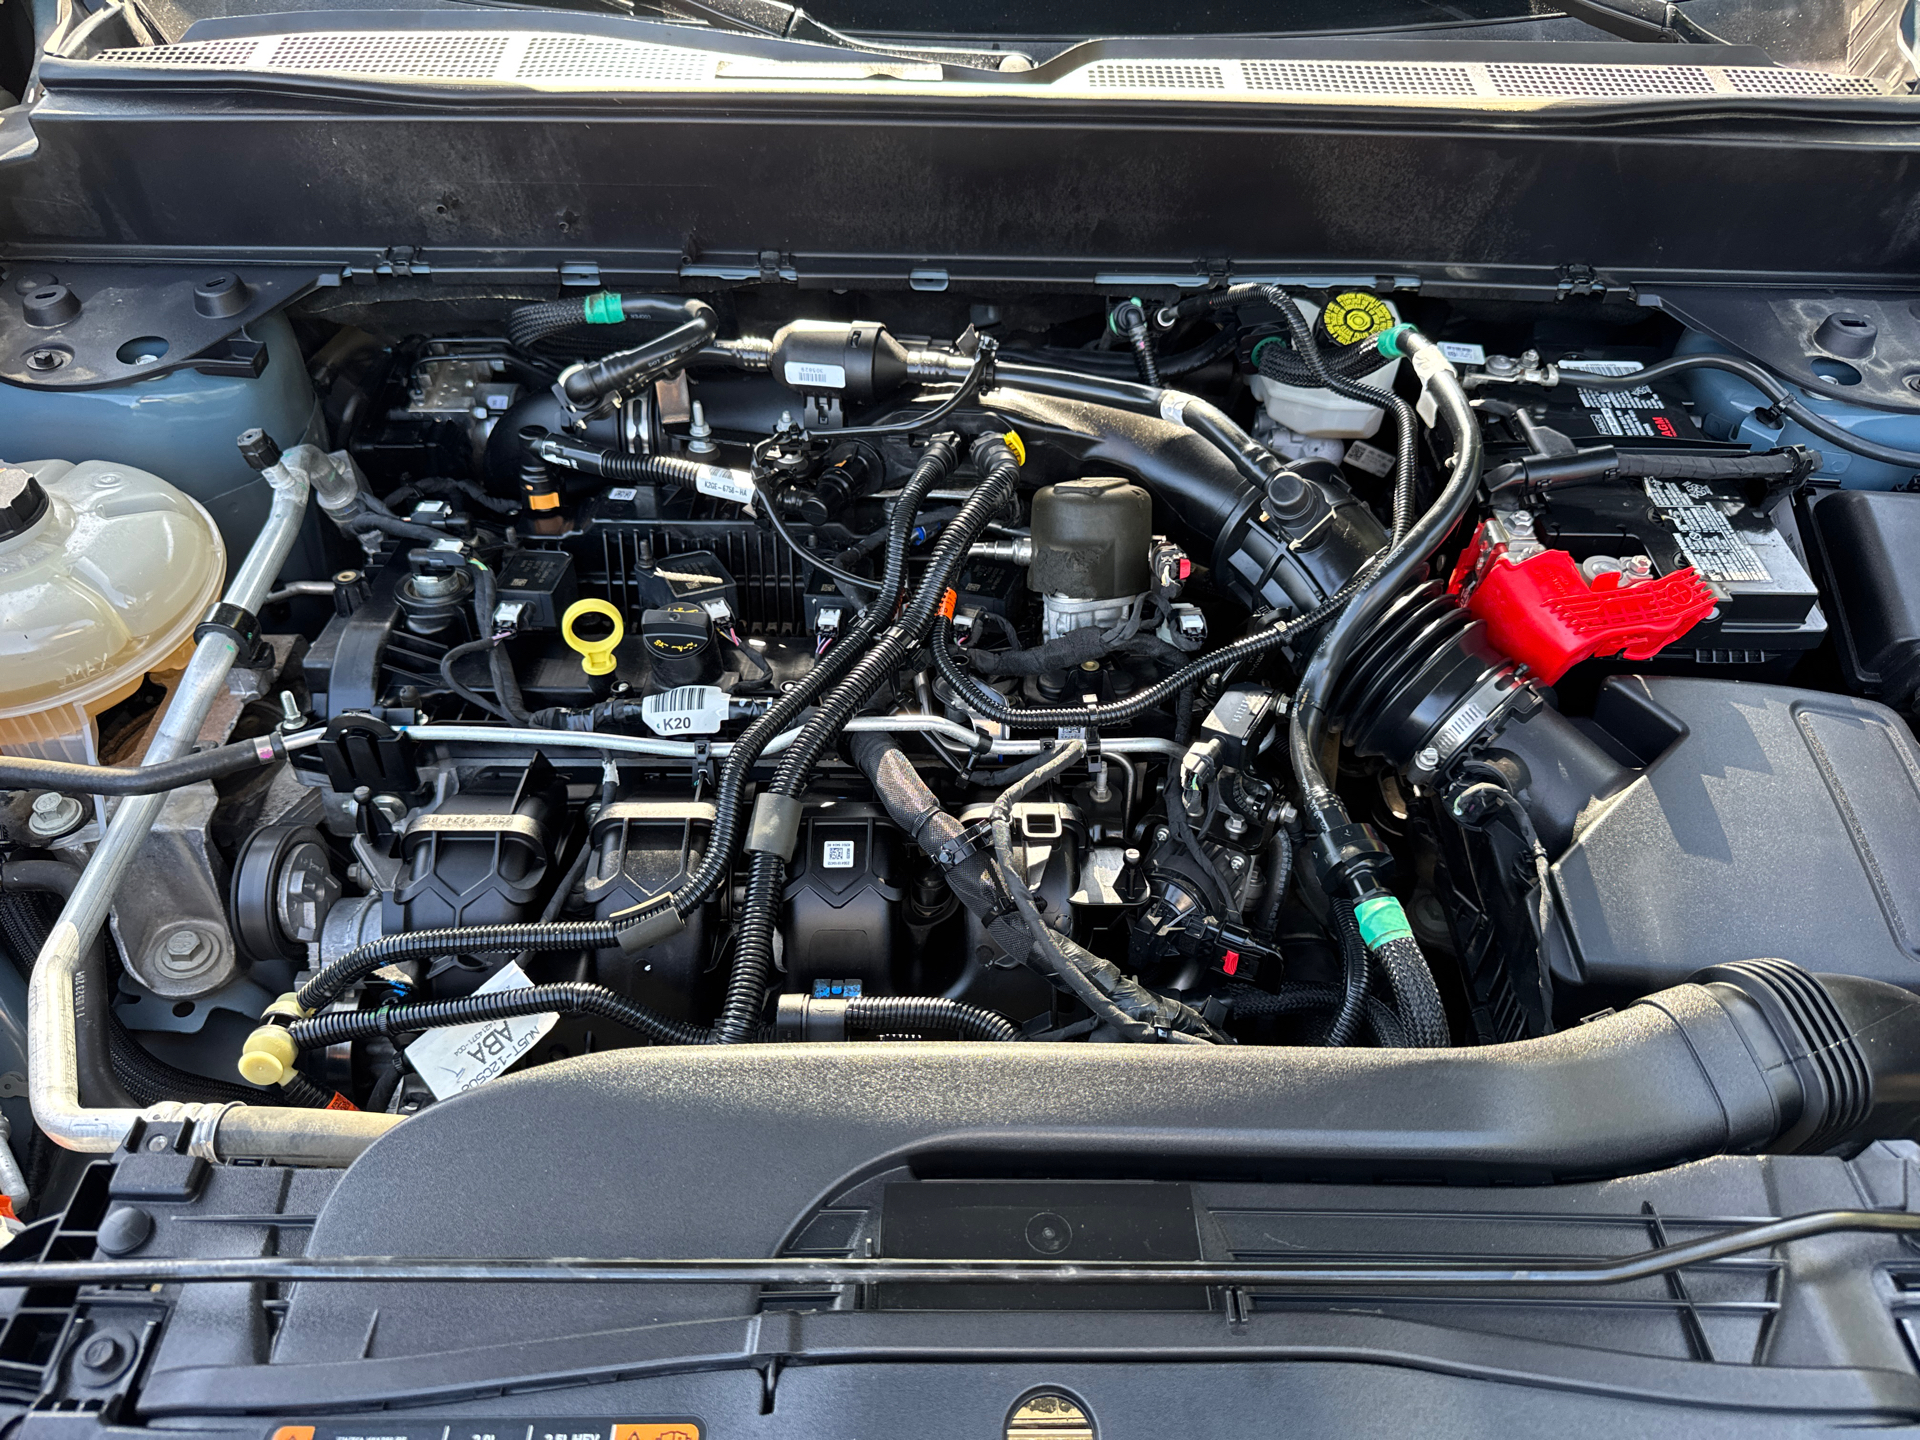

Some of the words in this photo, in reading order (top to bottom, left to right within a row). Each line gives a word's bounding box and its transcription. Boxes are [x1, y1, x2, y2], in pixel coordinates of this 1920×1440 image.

[1652, 417, 1673, 437] AGM
[65, 652, 114, 682] MAX
[663, 717, 691, 731] K20
[467, 1020, 514, 1065] ABA
